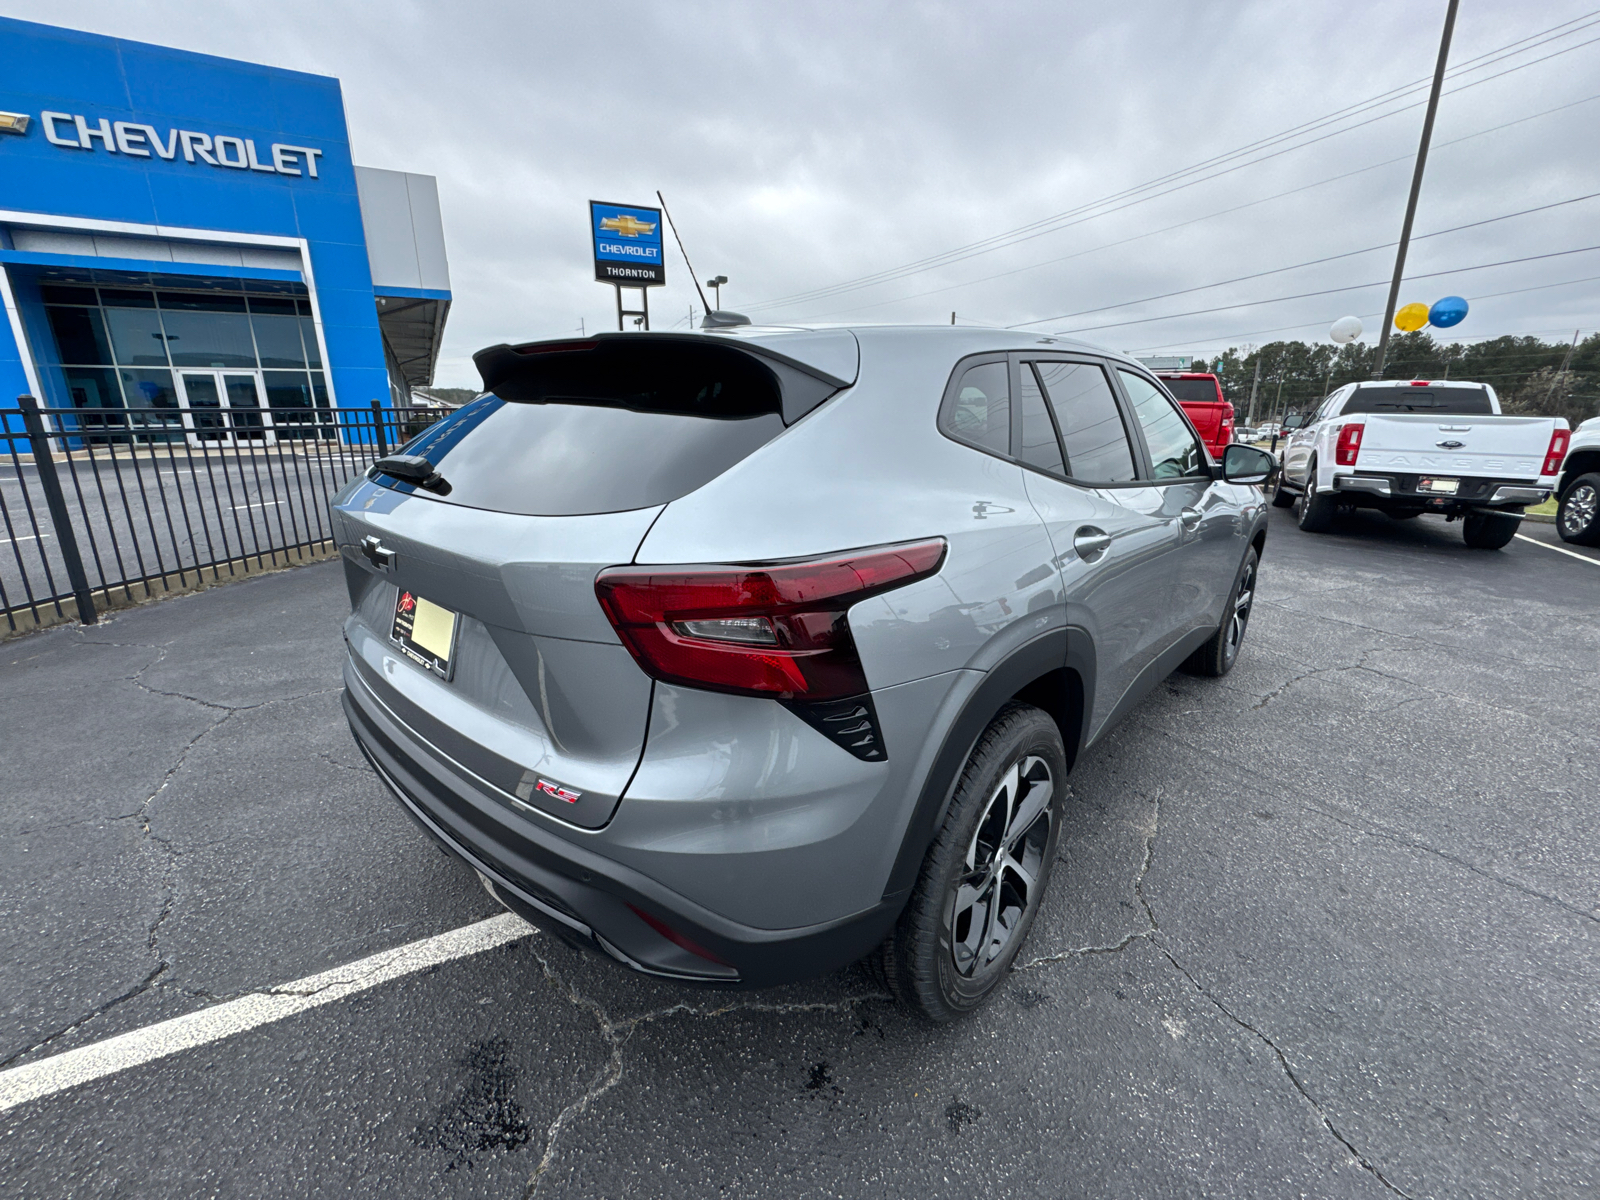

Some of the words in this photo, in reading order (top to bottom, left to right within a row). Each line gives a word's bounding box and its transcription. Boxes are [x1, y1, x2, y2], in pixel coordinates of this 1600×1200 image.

[41, 110, 322, 178] CHEVROLET
[600, 244, 658, 257] CHEVROLET
[607, 267, 656, 279] THORNTON
[1362, 454, 1536, 471] RANGER
[535, 779, 582, 804] RS
